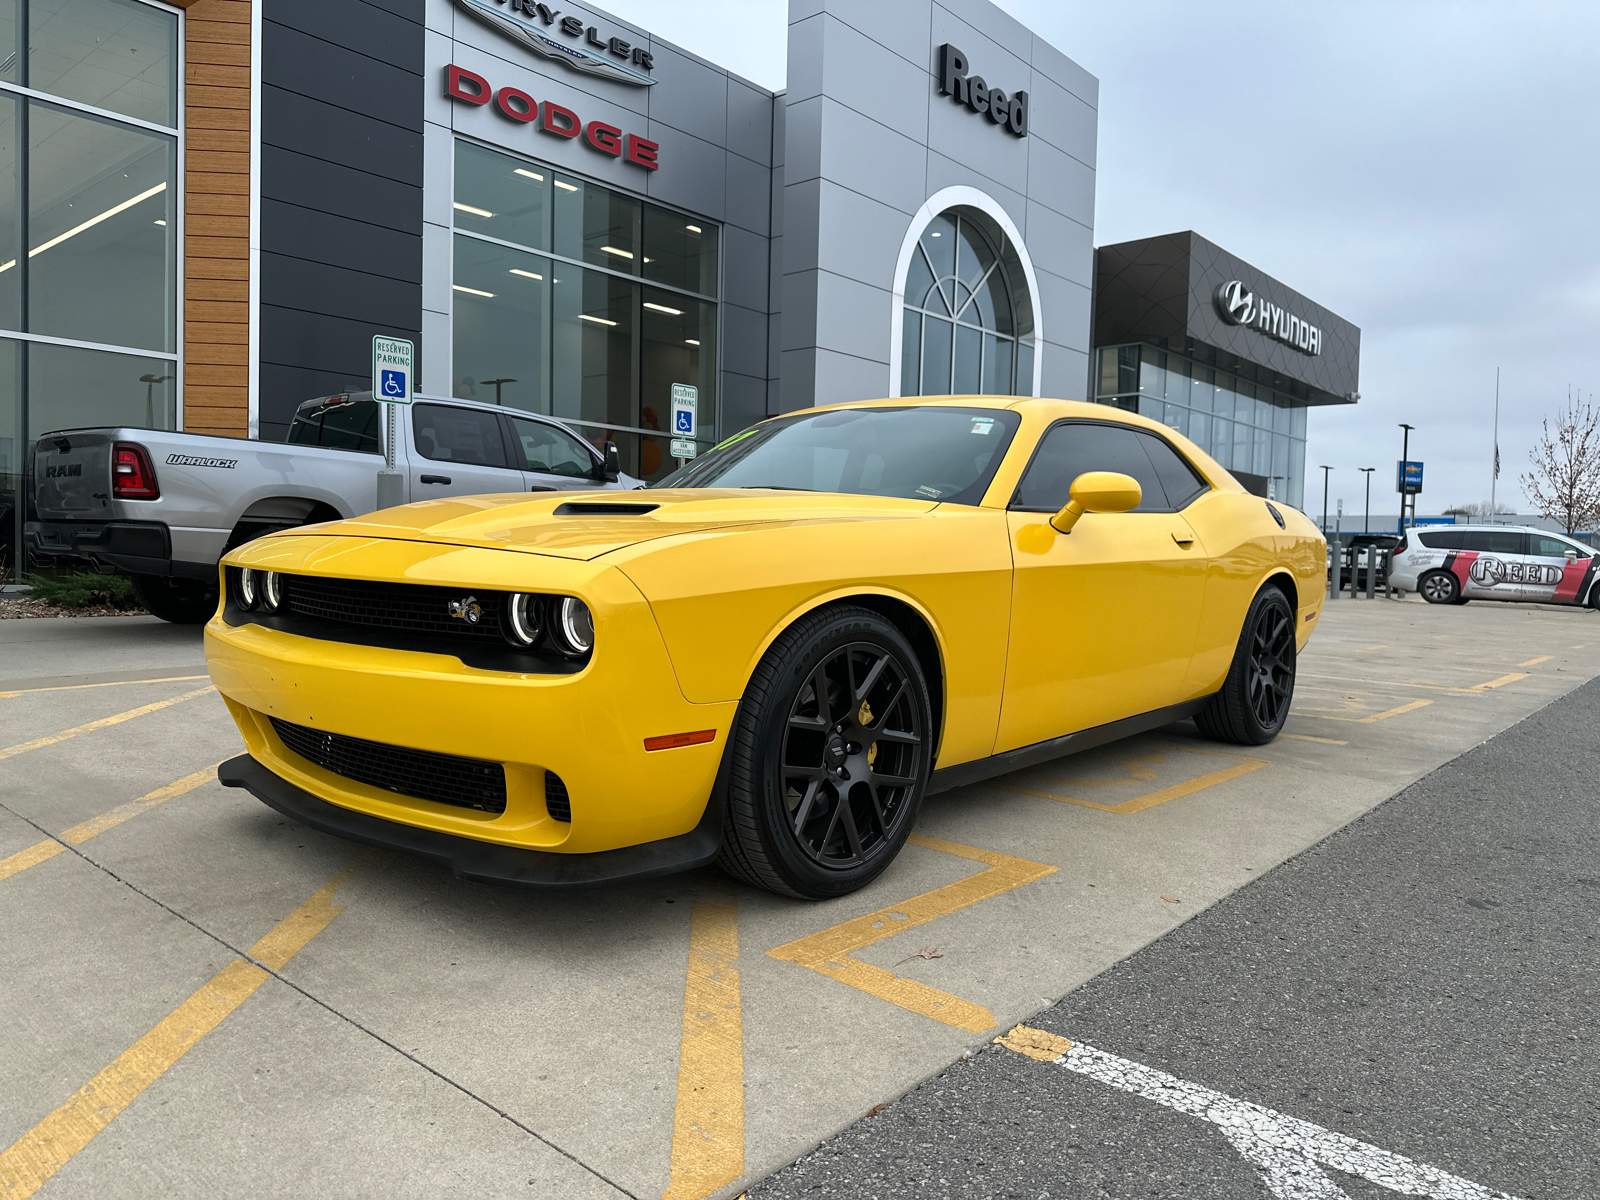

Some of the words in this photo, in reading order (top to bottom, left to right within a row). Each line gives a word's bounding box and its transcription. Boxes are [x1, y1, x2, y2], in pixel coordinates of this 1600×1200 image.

[939, 42, 1028, 139] Reed
[444, 63, 659, 173] DODGE
[1258, 298, 1322, 356] HYUNDAI
[377, 342, 409, 355] RESERVED
[377, 353, 409, 366] PARKING
[674, 388, 694, 398] RESERVED
[674, 397, 694, 407] PARKING
[165, 453, 238, 469] WARLOCK
[45, 463, 82, 478] RAM
[1470, 556, 1563, 587] REED
[794, 622, 872, 676] GOODYEAR
